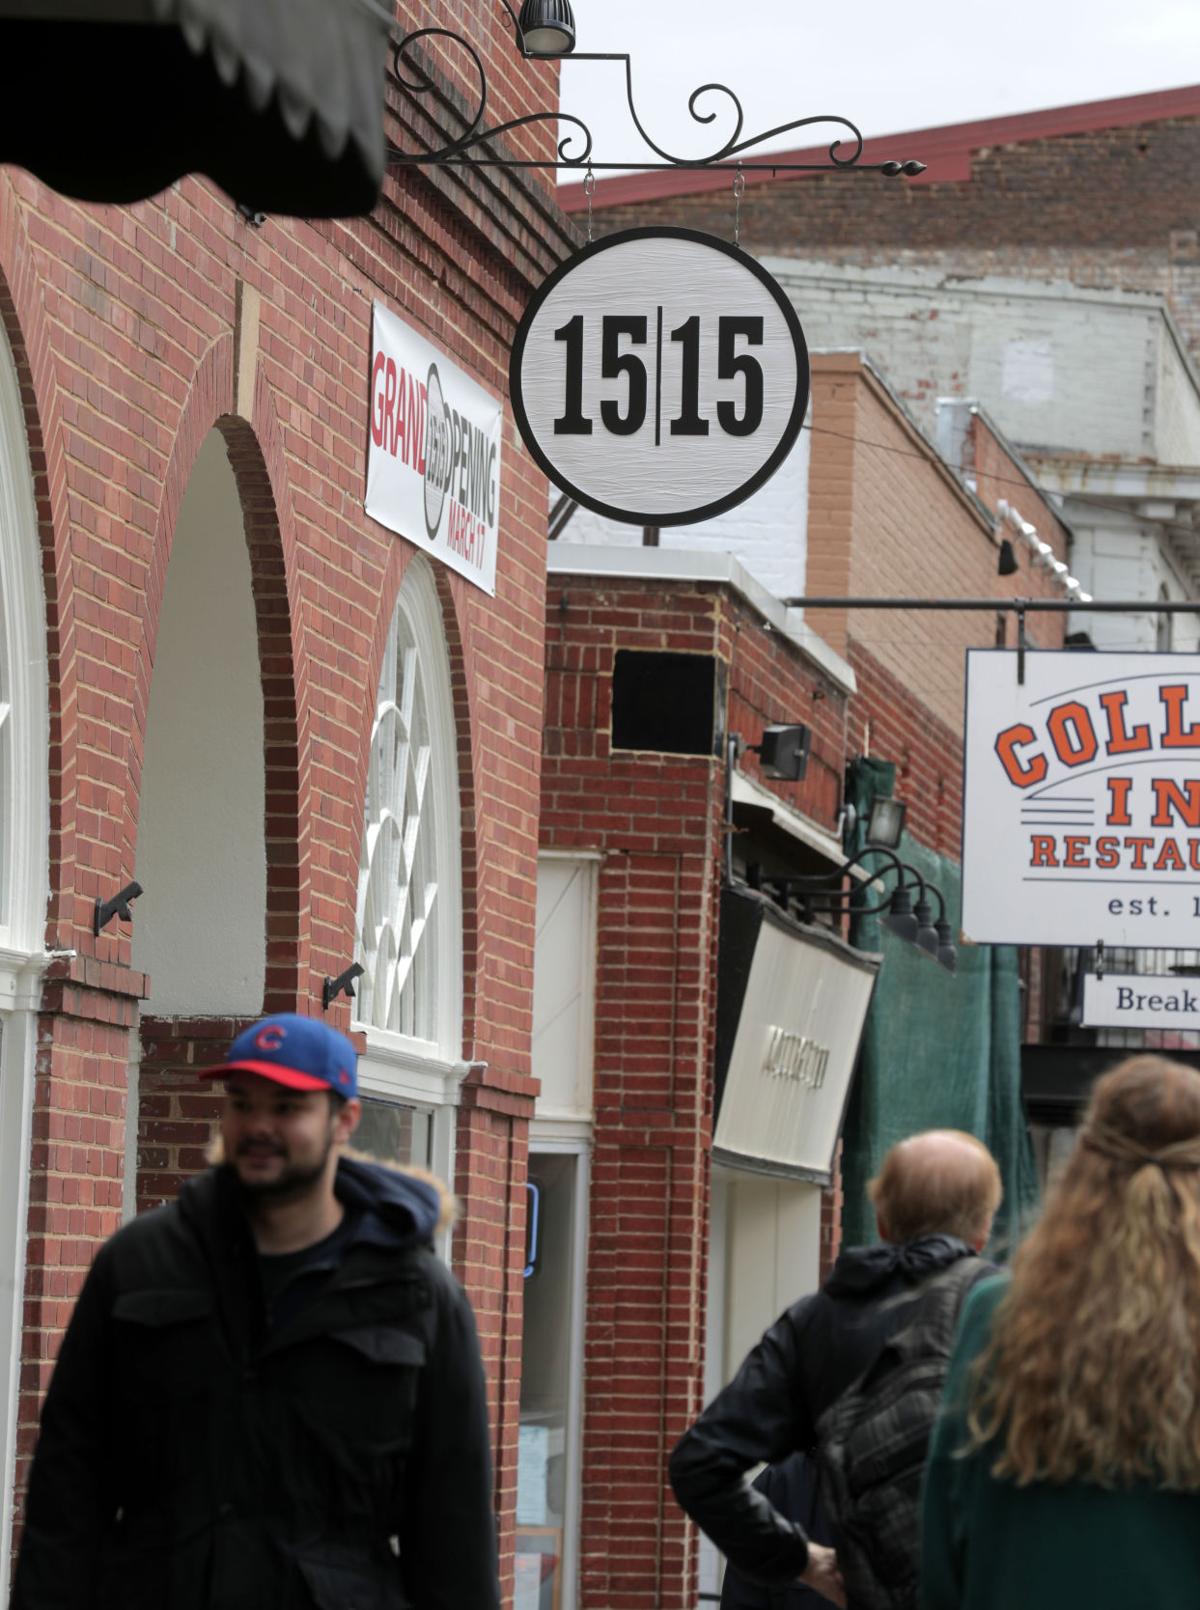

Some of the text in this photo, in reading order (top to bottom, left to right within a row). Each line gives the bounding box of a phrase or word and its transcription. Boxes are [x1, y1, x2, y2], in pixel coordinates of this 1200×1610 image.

[371, 351, 428, 476] GRAND
[447, 499, 486, 570] MARCH 17
[994, 684, 1200, 789] COLL
[1106, 777, 1200, 828] IN
[1108, 897, 1170, 916] est.
[1116, 987, 1199, 1012] Break
[256, 1024, 287, 1050] C
